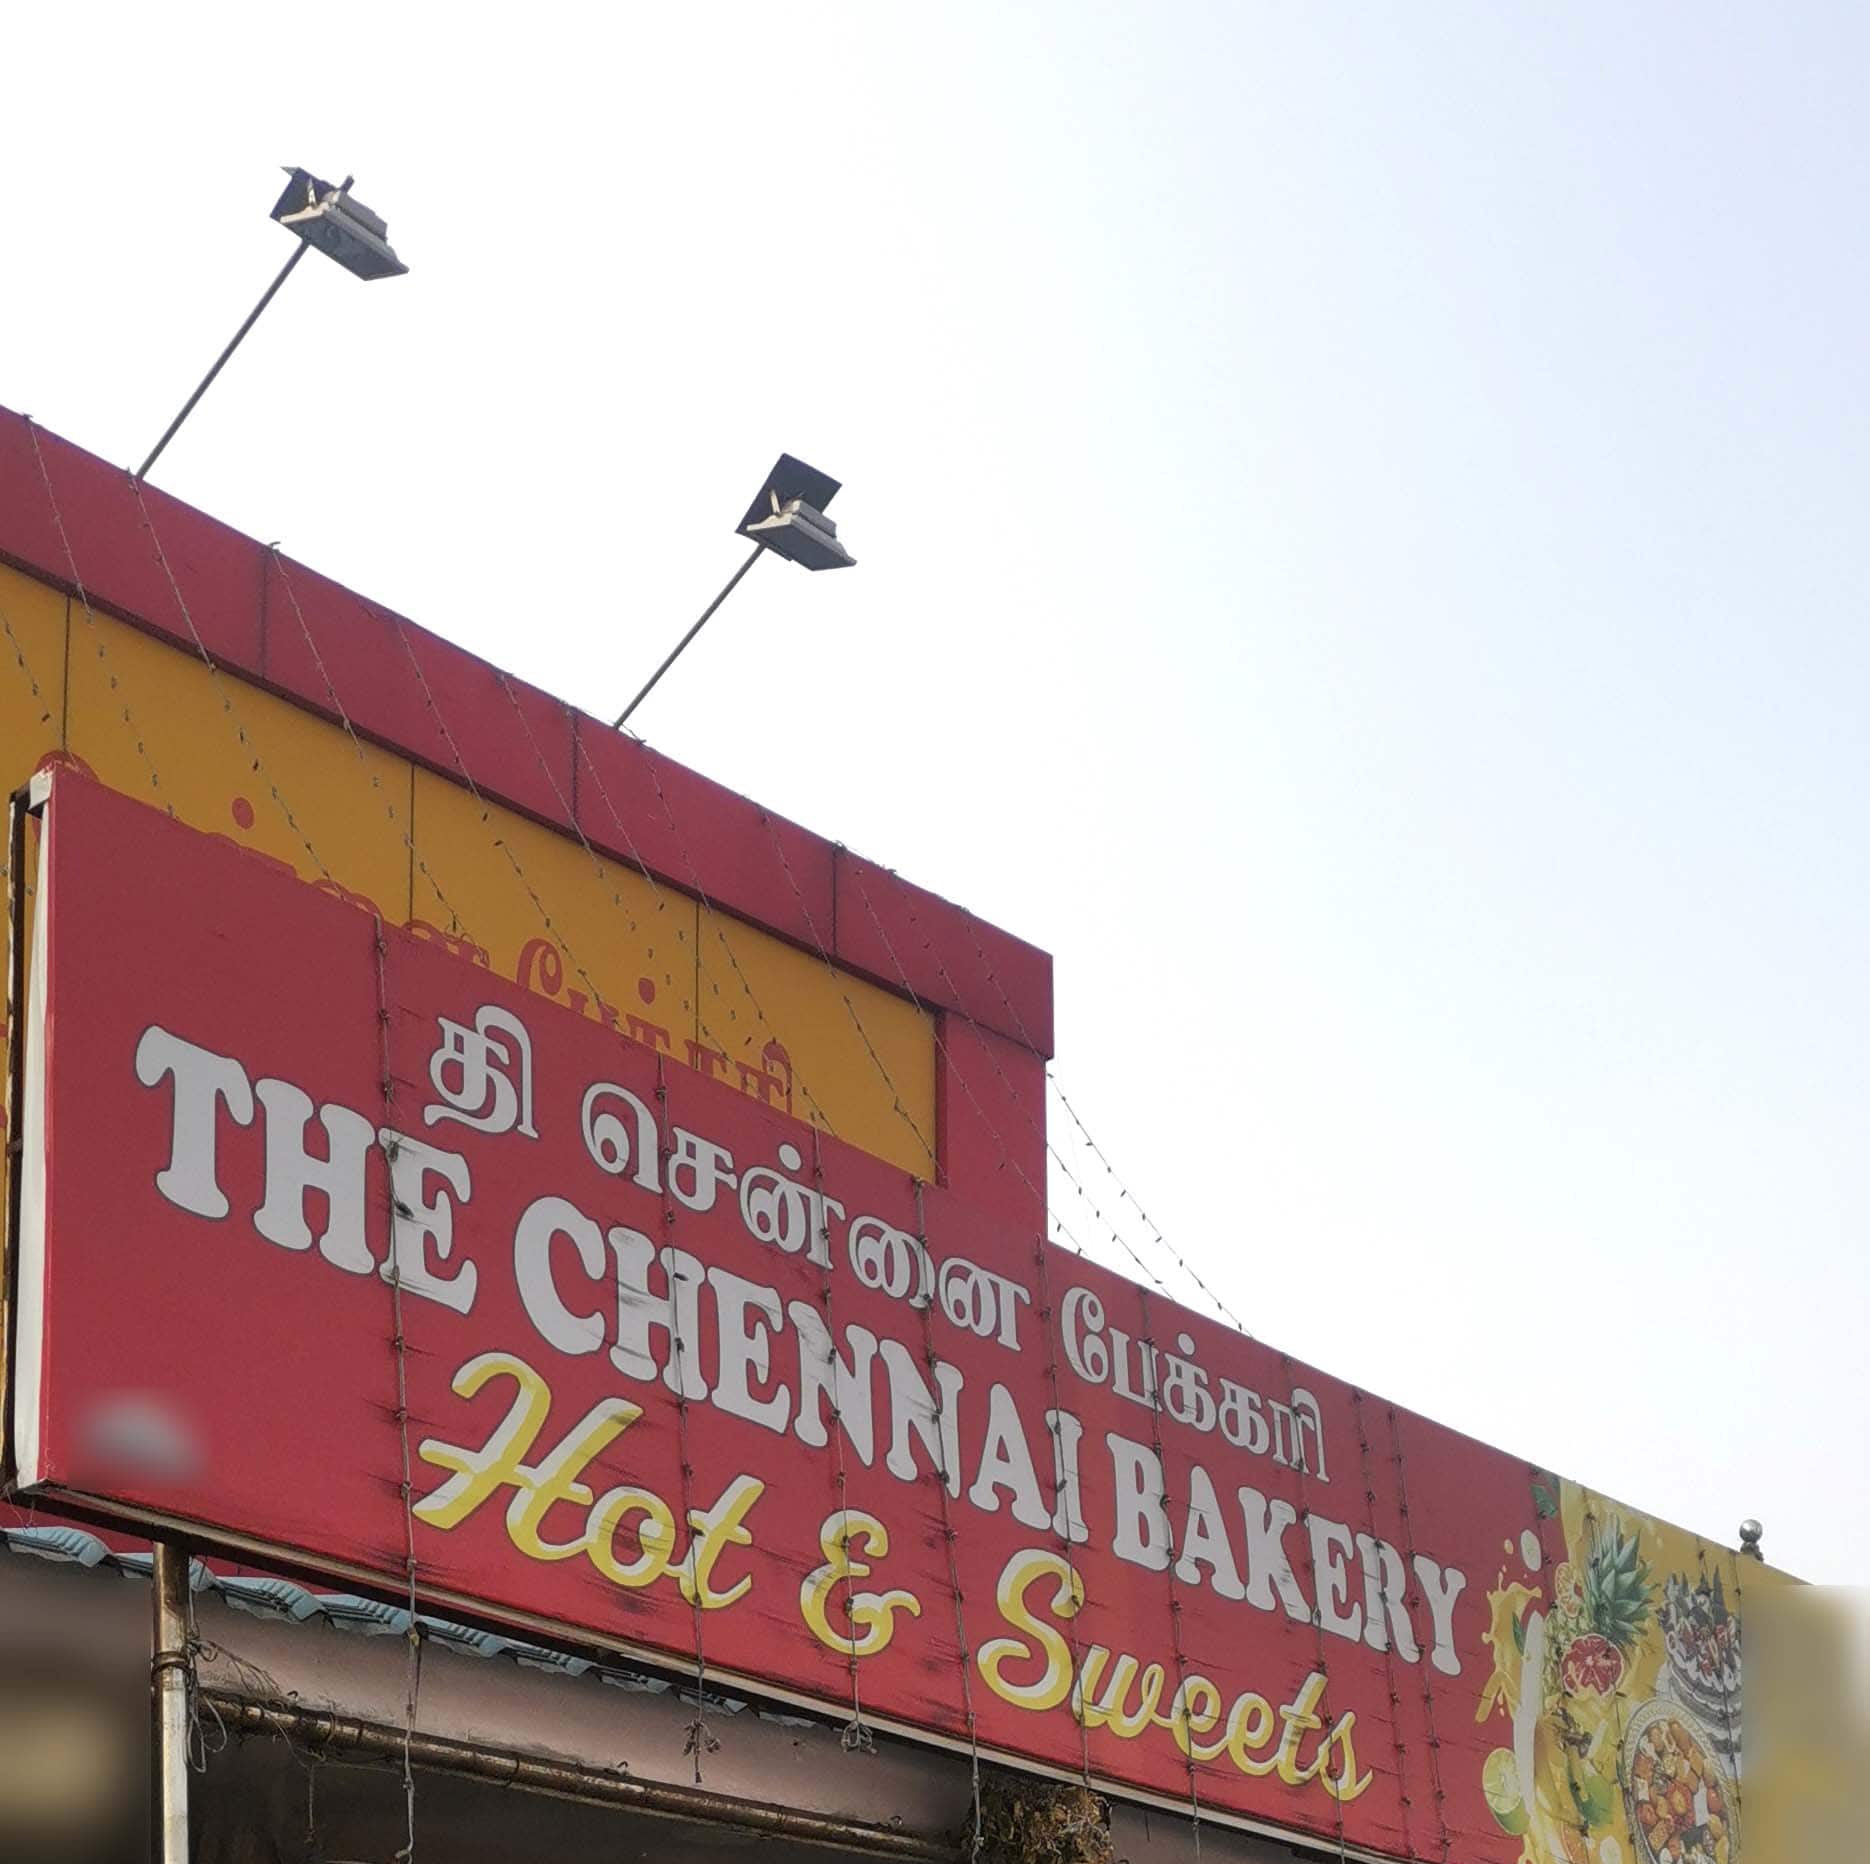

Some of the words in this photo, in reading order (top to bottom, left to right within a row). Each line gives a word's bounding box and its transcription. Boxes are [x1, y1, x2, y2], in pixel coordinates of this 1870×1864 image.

[134, 1024, 479, 1315] THE
[513, 1195, 1089, 1544] CHENNAI
[1105, 1431, 1468, 1677] BAKERY
[424, 1003, 540, 1140] தி
[580, 1081, 1031, 1353] சென்னை
[1061, 1285, 1331, 1484] பேக்கரி
[411, 1351, 766, 1610] Hot
[800, 1507, 922, 1656] &
[975, 1547, 1374, 1802] Sweets
